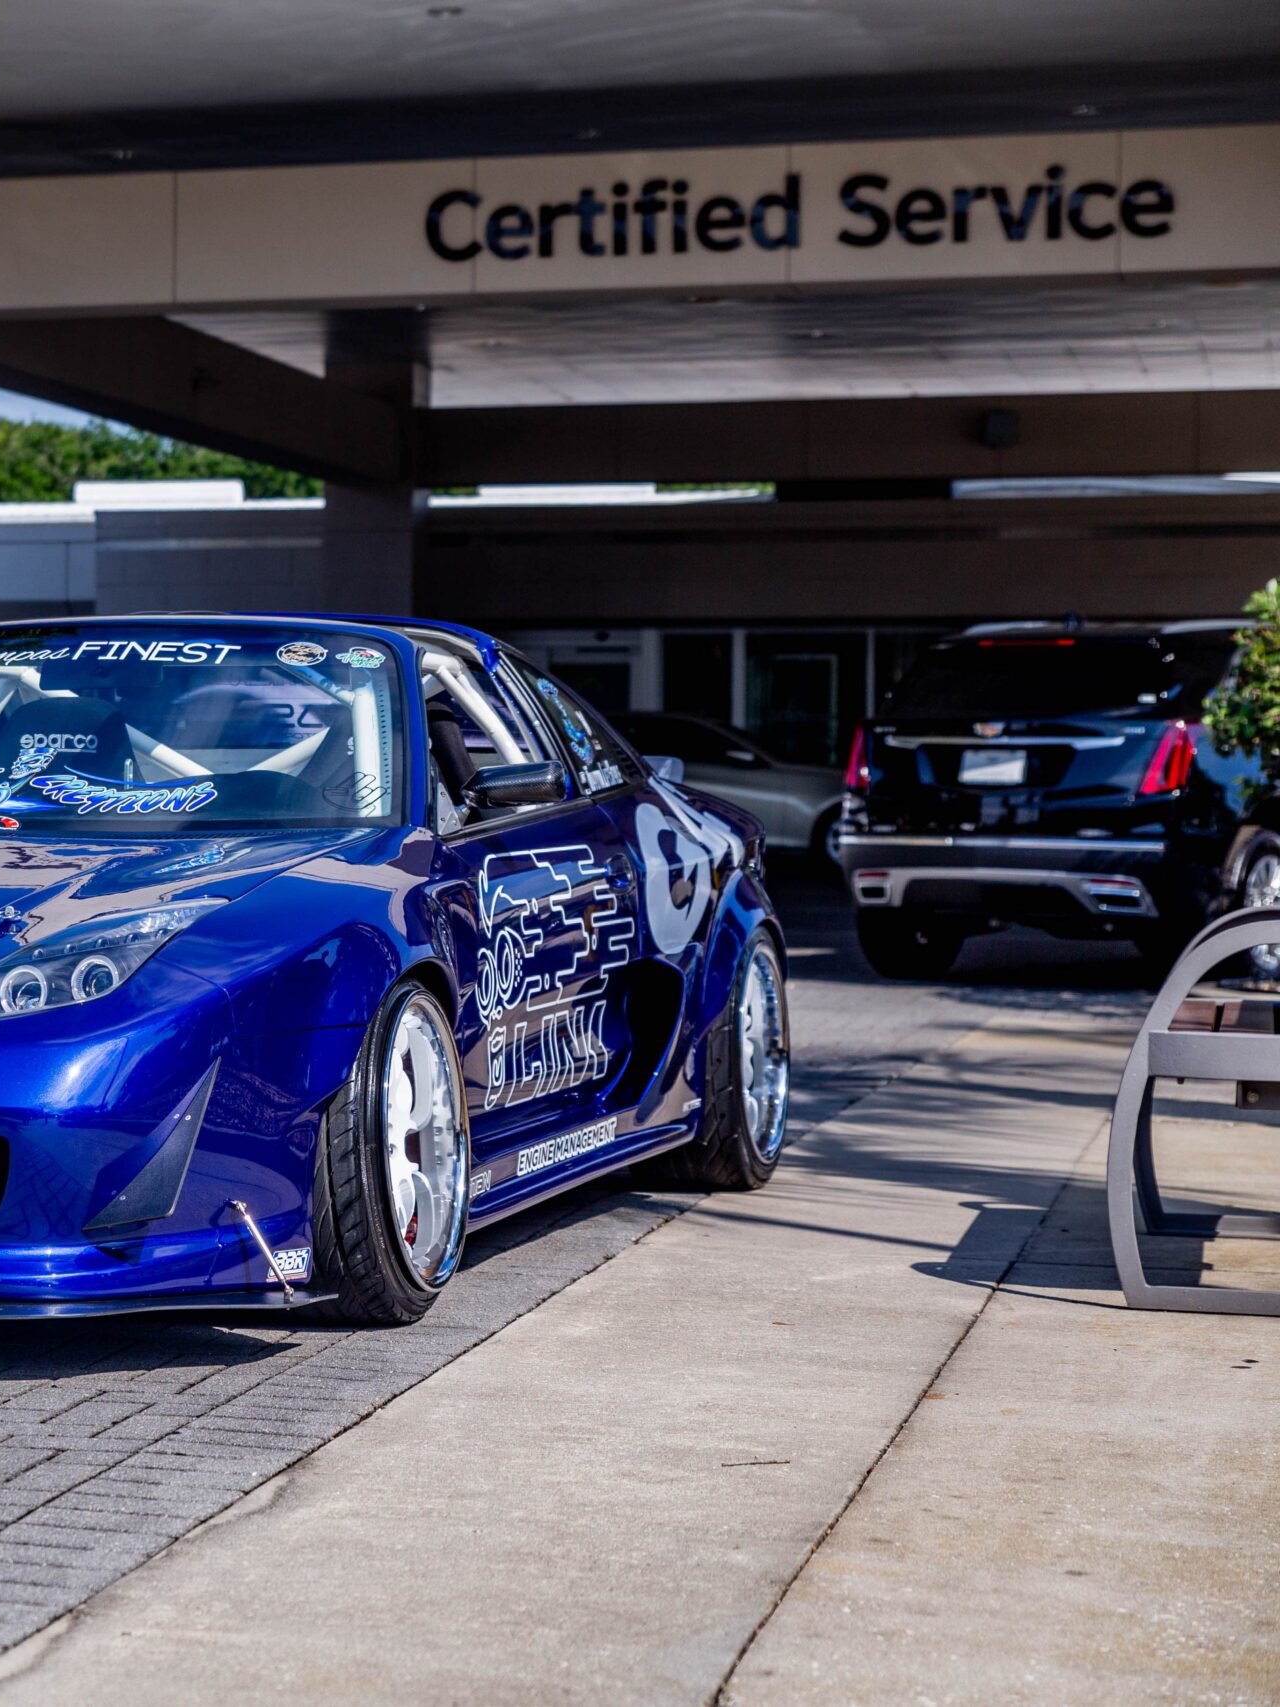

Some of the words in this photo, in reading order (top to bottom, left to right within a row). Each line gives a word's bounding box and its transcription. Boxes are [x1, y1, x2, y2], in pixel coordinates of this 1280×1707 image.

[424, 172, 802, 262] Certified
[836, 164, 1176, 248] Service
[72, 641, 241, 664] FINEST
[20, 733, 98, 751] sparco
[518, 1140, 554, 1175] ENGINE
[554, 1117, 617, 1162] MANAGEMENT
[273, 1249, 309, 1272] BBK
